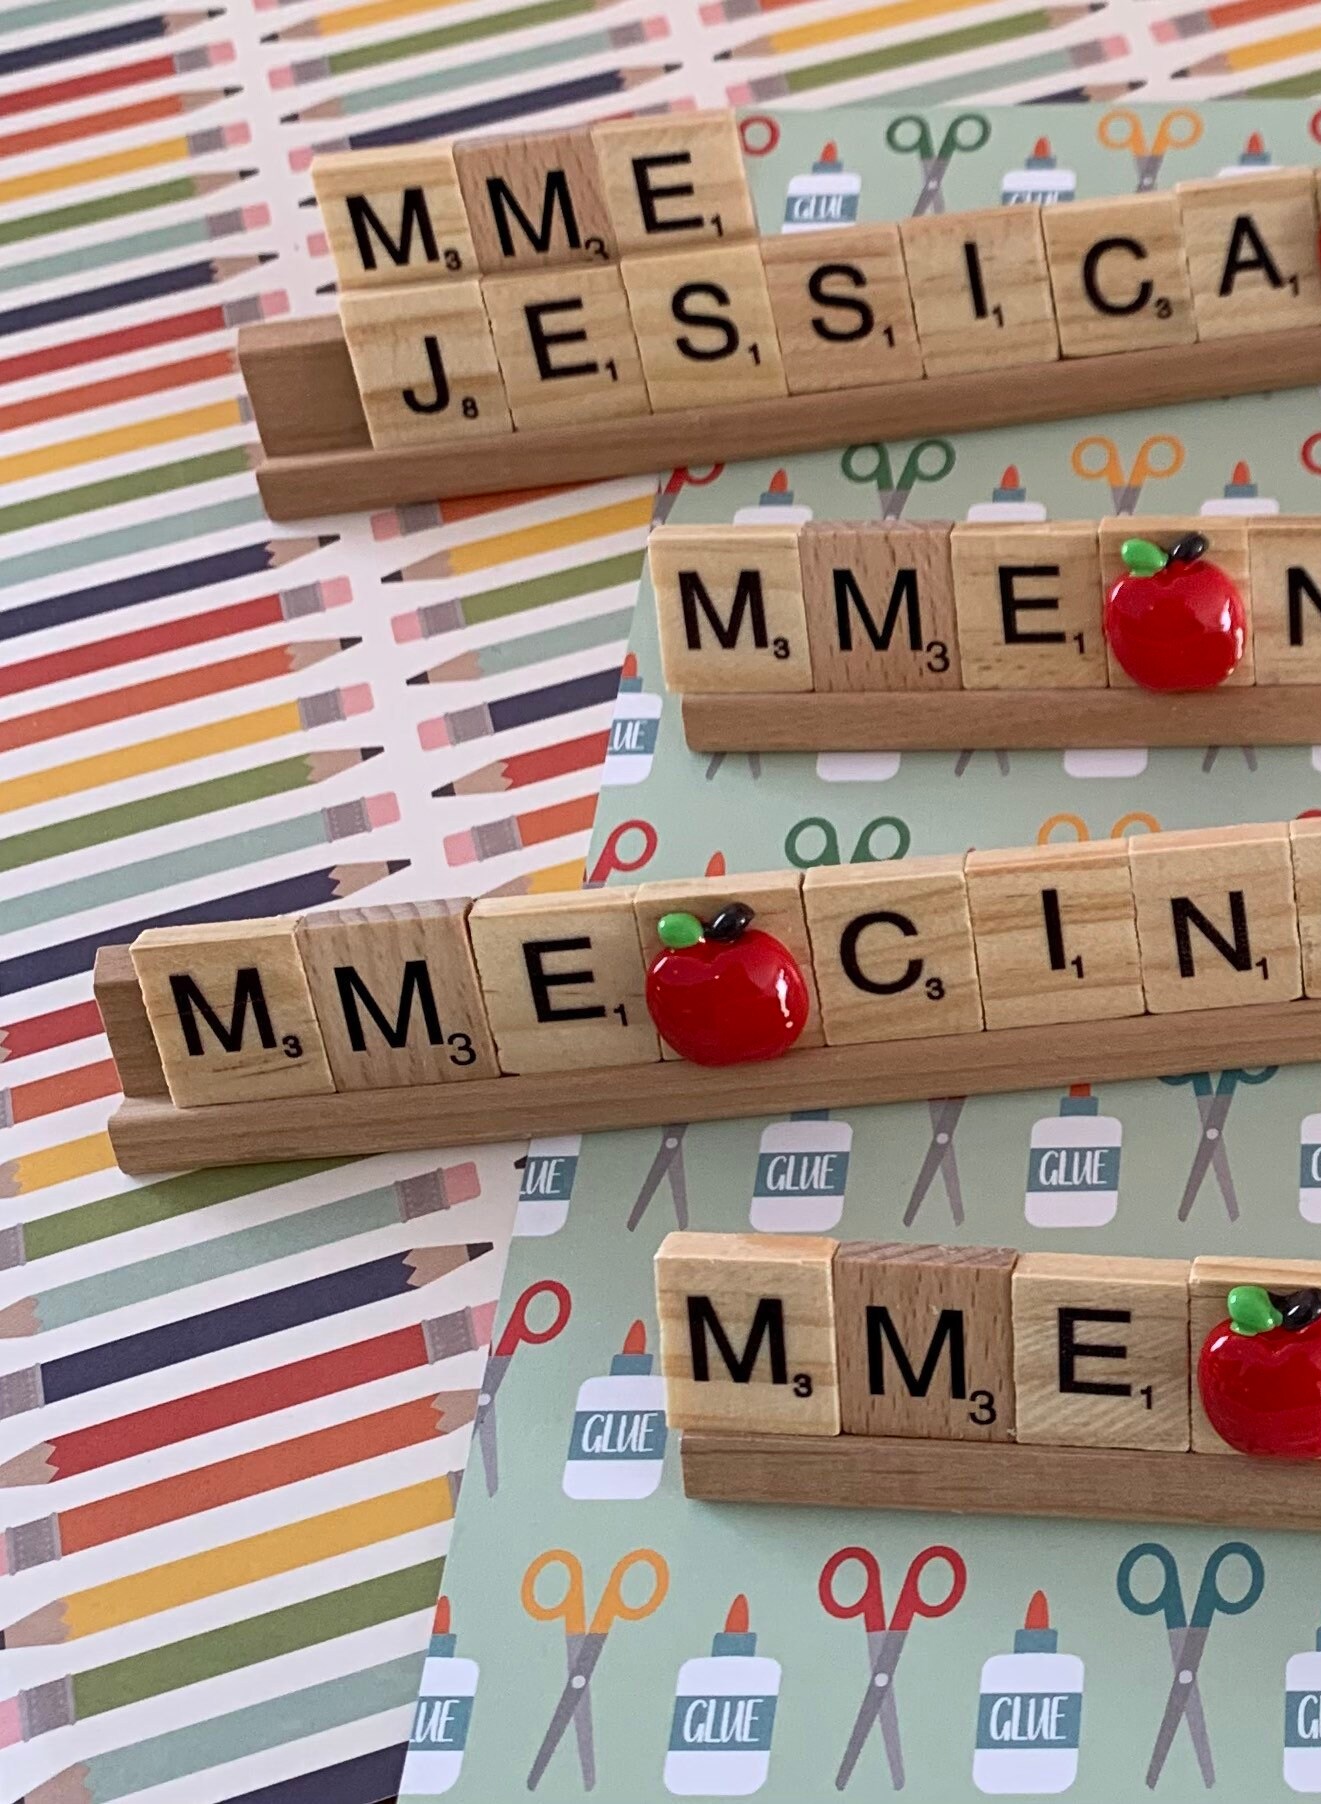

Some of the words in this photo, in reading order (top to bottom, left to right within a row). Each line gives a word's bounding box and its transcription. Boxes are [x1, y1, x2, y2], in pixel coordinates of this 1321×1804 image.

[346, 153, 703, 269] MME
[444, 249, 462, 271] 3
[711, 215, 723, 236] 1
[402, 216, 1283, 414] JESSICA
[461, 396, 479, 419] 8
[605, 360, 618, 381] 1
[749, 344, 761, 364] 1
[883, 326, 895, 347] 1
[992, 306, 1003, 326] 1
[1155, 298, 1172, 319] 3
[1288, 274, 1299, 295] 1
[679, 566, 1066, 651] MME
[773, 637, 790, 660] 3
[926, 640, 950, 673] 3
[1073, 632, 1085, 654] 1
[169, 937, 607, 1056] MME
[281, 1034, 304, 1059] 3
[447, 1032, 477, 1066] 3
[612, 1003, 629, 1027] 1
[925, 977, 946, 1001] 3
[1071, 955, 1084, 979] 1
[1255, 957, 1269, 980] 1
[768, 1155, 838, 1190] GLUE
[1039, 1149, 1109, 1184] GLUE
[687, 1296, 1132, 1399] MME
[792, 1372, 813, 1398] 3
[968, 1389, 997, 1426] 3
[1140, 1385, 1153, 1410] 1
[582, 1413, 657, 1453] GLUE
[683, 1698, 763, 1742] GLUE
[990, 1695, 1068, 1740] GLUE
